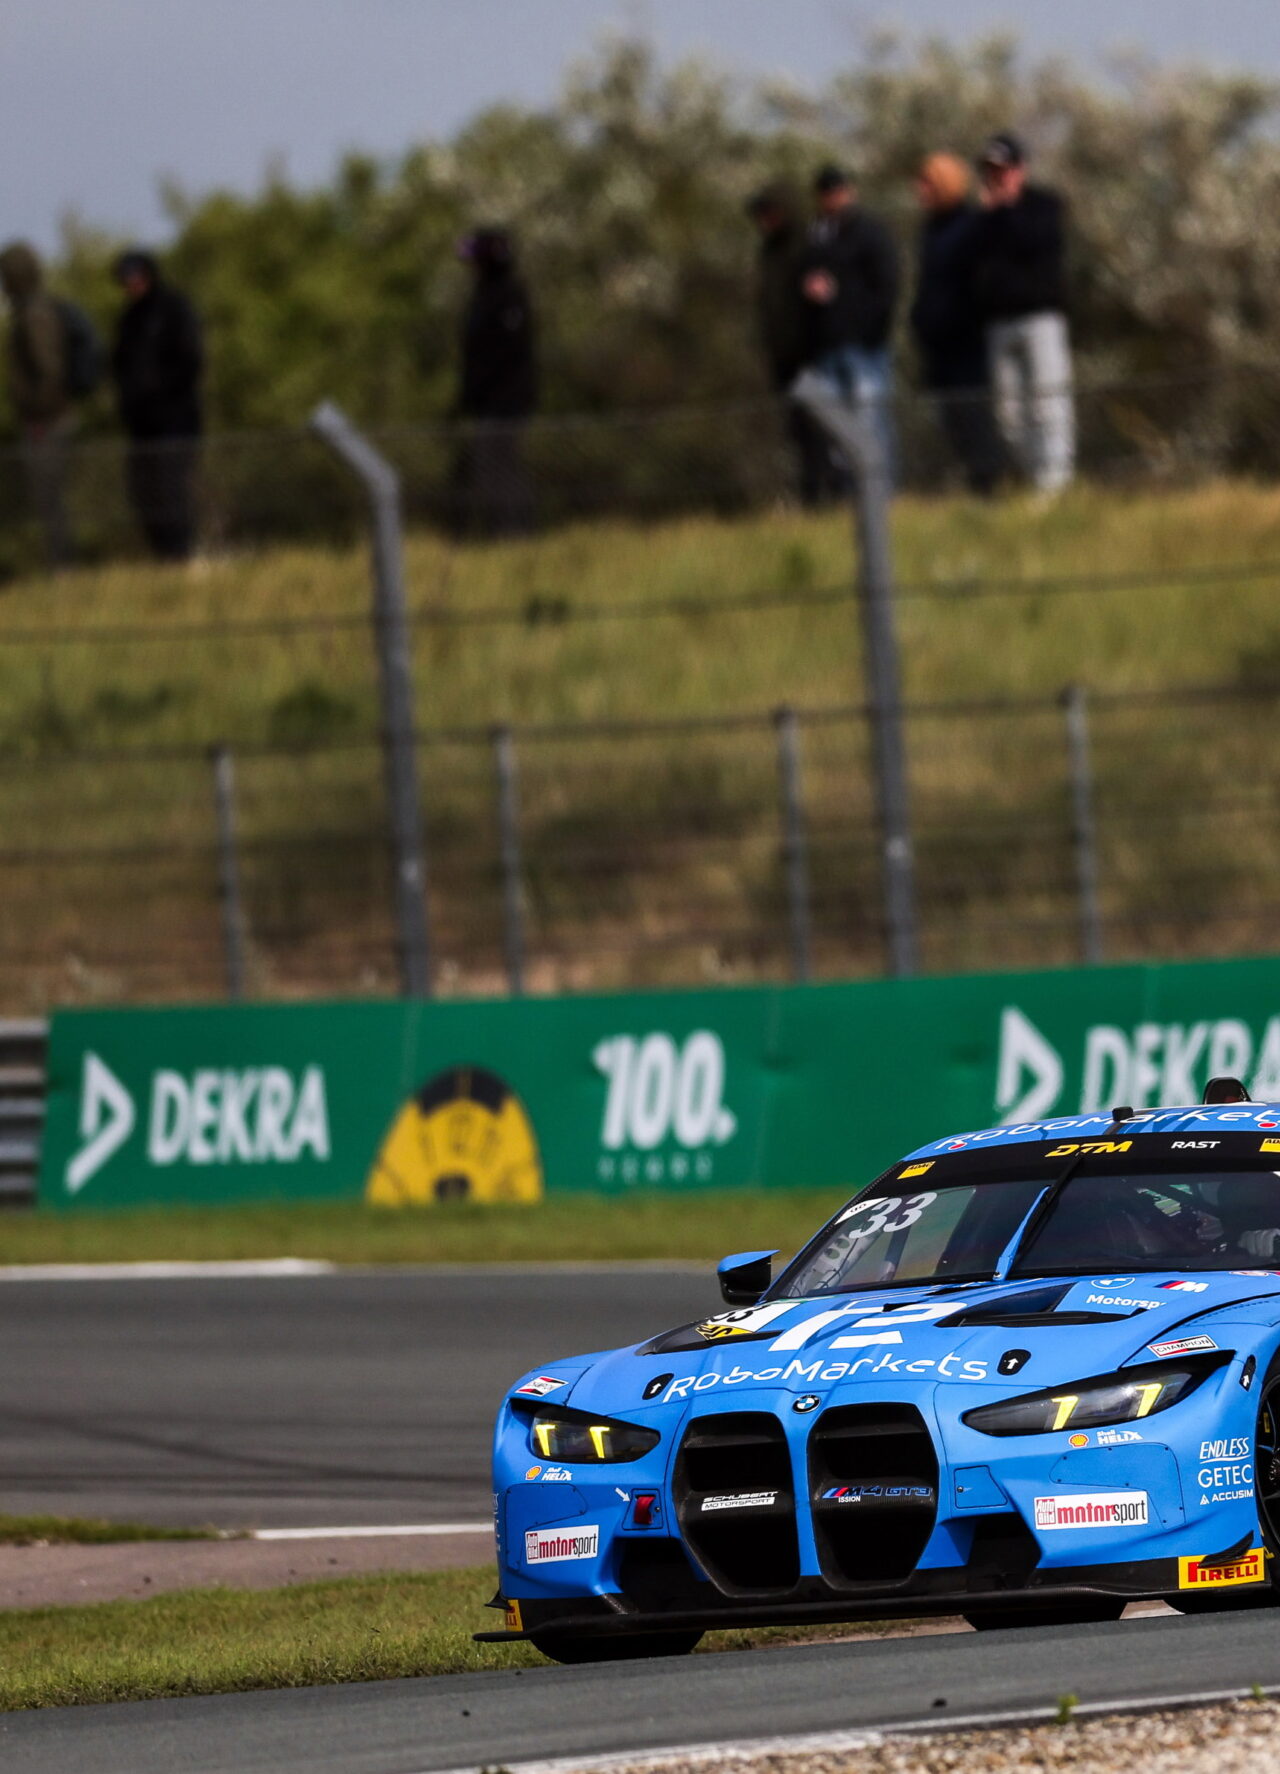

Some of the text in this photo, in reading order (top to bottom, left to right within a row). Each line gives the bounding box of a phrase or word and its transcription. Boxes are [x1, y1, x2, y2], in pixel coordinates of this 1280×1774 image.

[149, 1065, 330, 1164] DEKRA
[1045, 1140, 1133, 1157] DTM
[1171, 1141, 1221, 1149] RAST
[849, 1192, 937, 1239] 33
[1156, 1340, 1209, 1353] CHAMPION
[662, 1352, 987, 1402] RoboMarkets
[1098, 1431, 1143, 1444] HELIX
[1200, 1437, 1249, 1459] ENDLESS
[1198, 1464, 1253, 1488] GETEC
[703, 1491, 778, 1502] SCHUBERT
[885, 1487, 932, 1497] GT3
[1211, 1489, 1253, 1503] ACCUSIM
[704, 1498, 773, 1510] MOTORSPORT
[1057, 1500, 1146, 1524] motorsport
[540, 1533, 597, 1559] motorsport
[1188, 1555, 1258, 1582] PIRELLI
